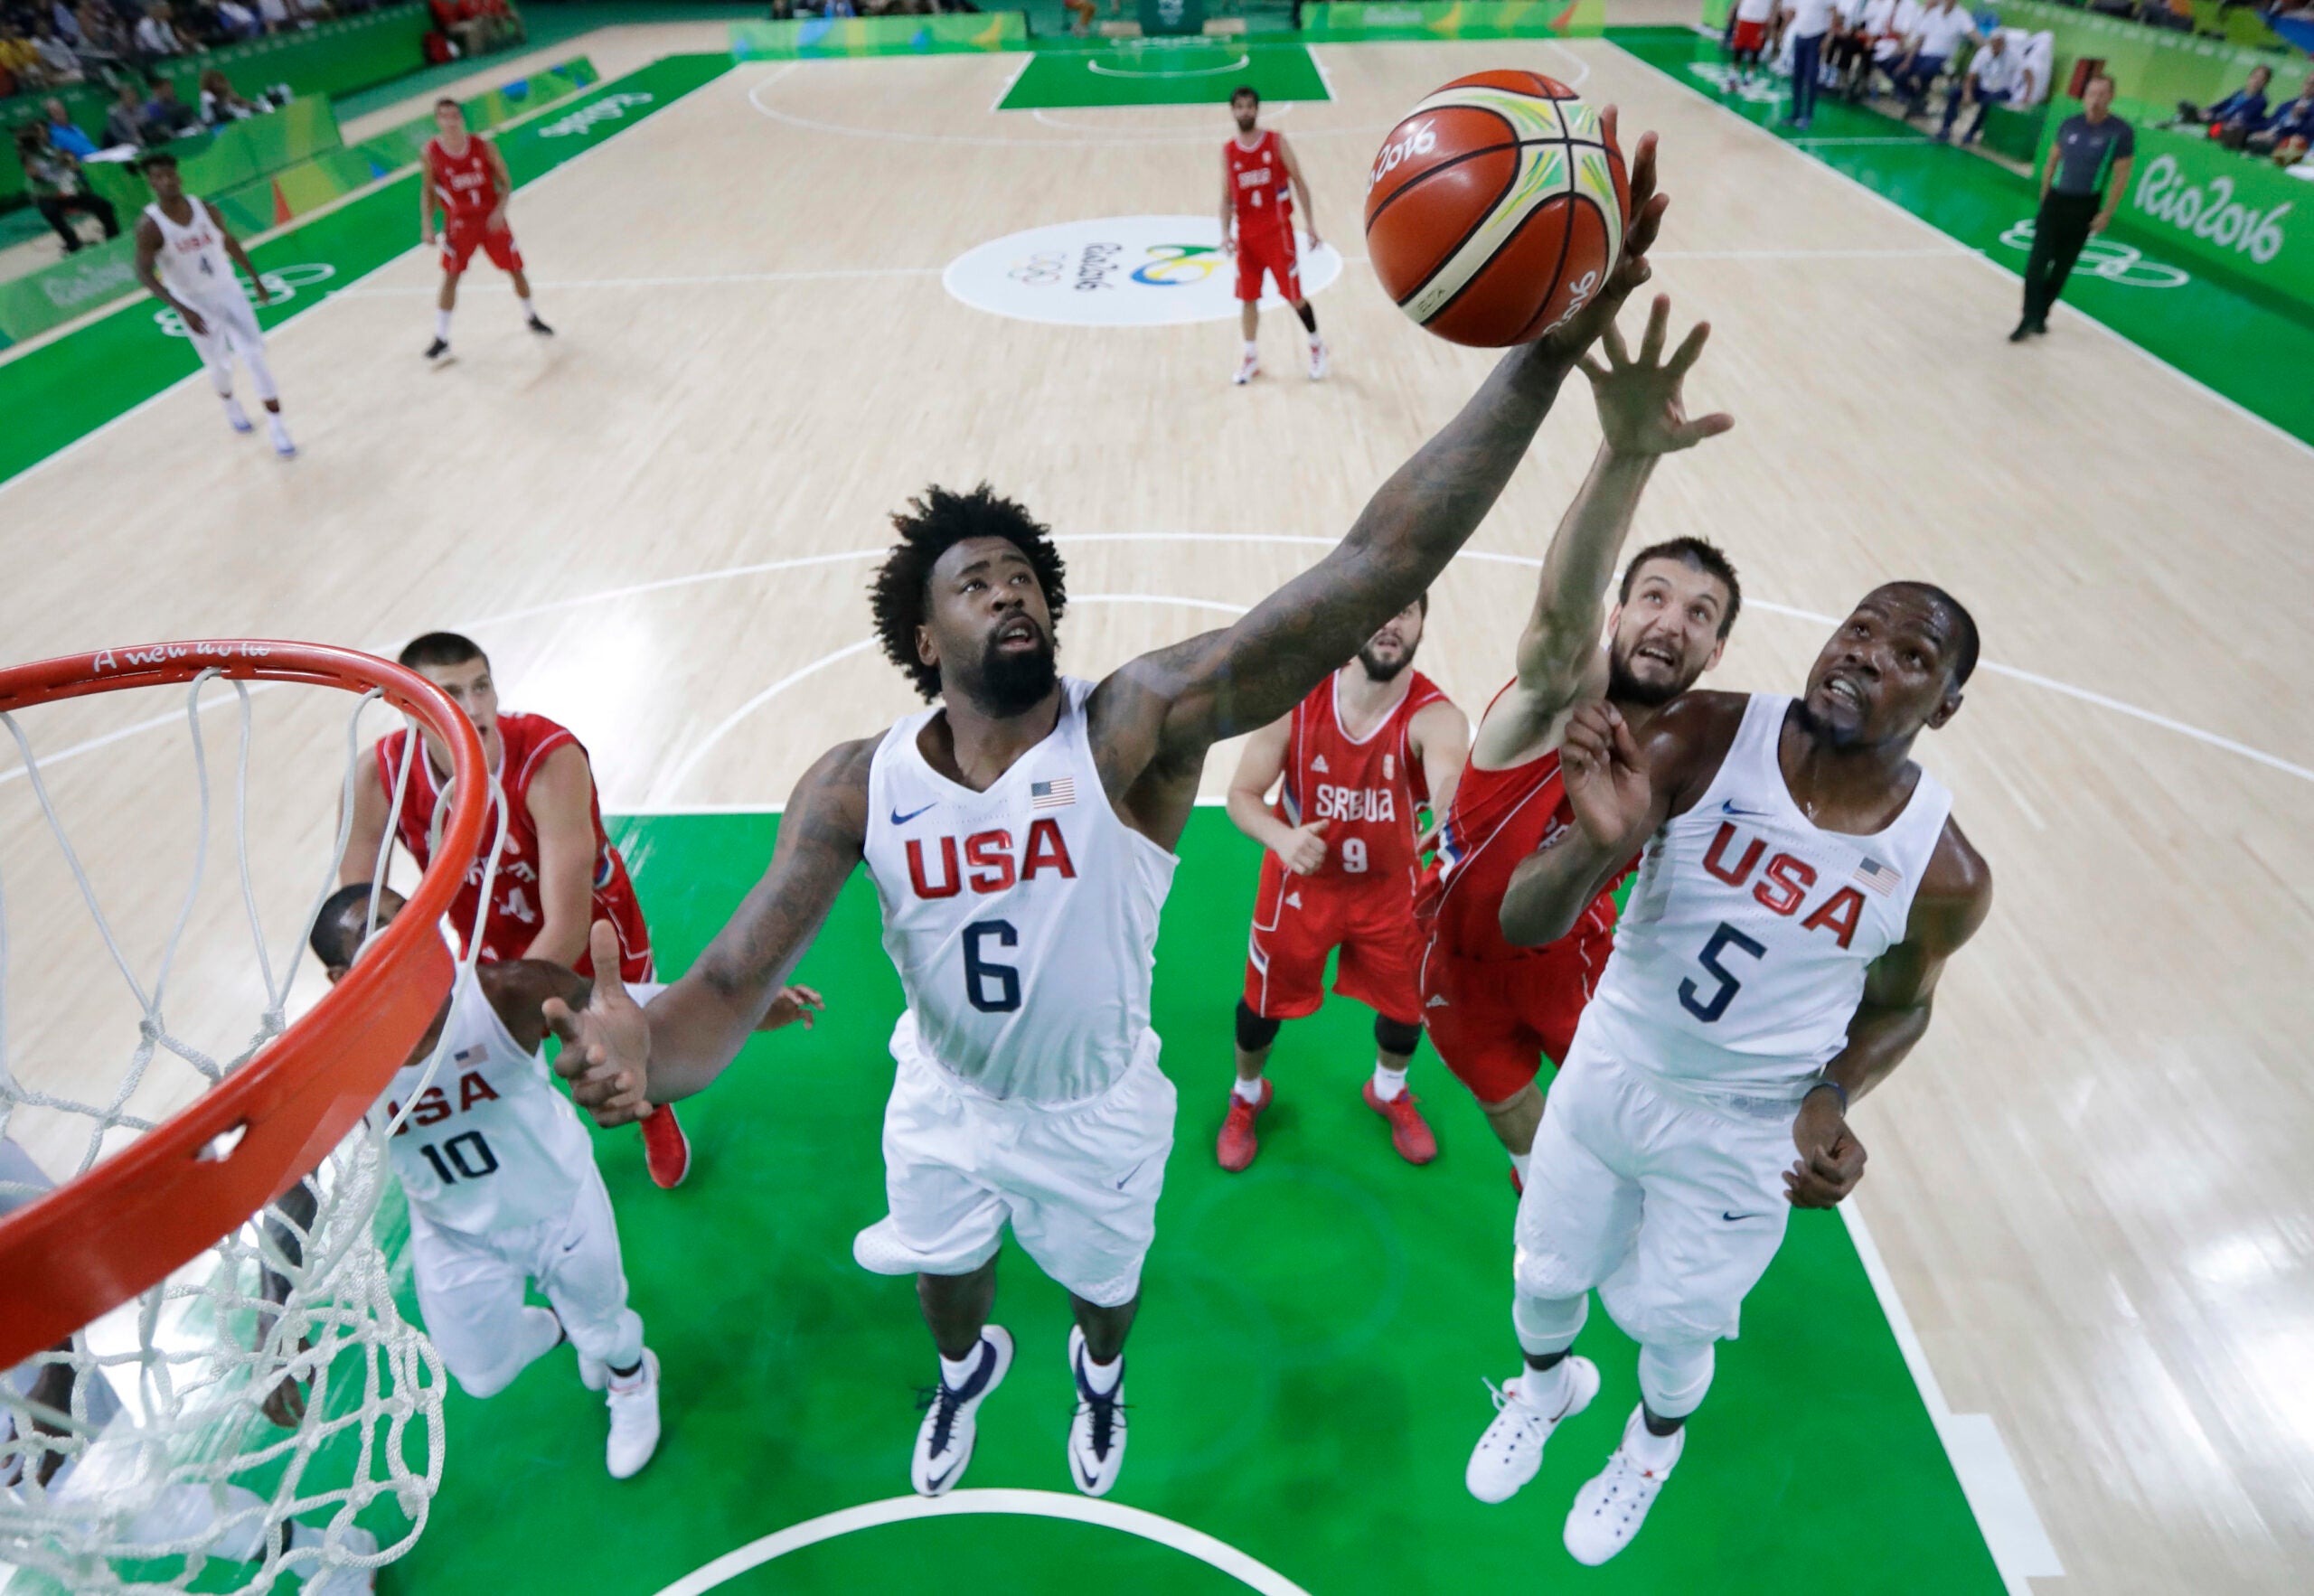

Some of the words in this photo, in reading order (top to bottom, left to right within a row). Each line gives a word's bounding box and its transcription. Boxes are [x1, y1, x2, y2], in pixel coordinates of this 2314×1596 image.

[2134, 154, 2293, 264] Rio2016
[200, 255, 214, 277] 4
[93, 649, 118, 672] A
[905, 818, 1077, 900] USA
[1341, 838, 1368, 873] 9
[1702, 821, 1867, 950] USA
[962, 919, 1021, 1013] 6
[1678, 921, 1768, 1023] 5
[419, 1131, 500, 1185] 10
